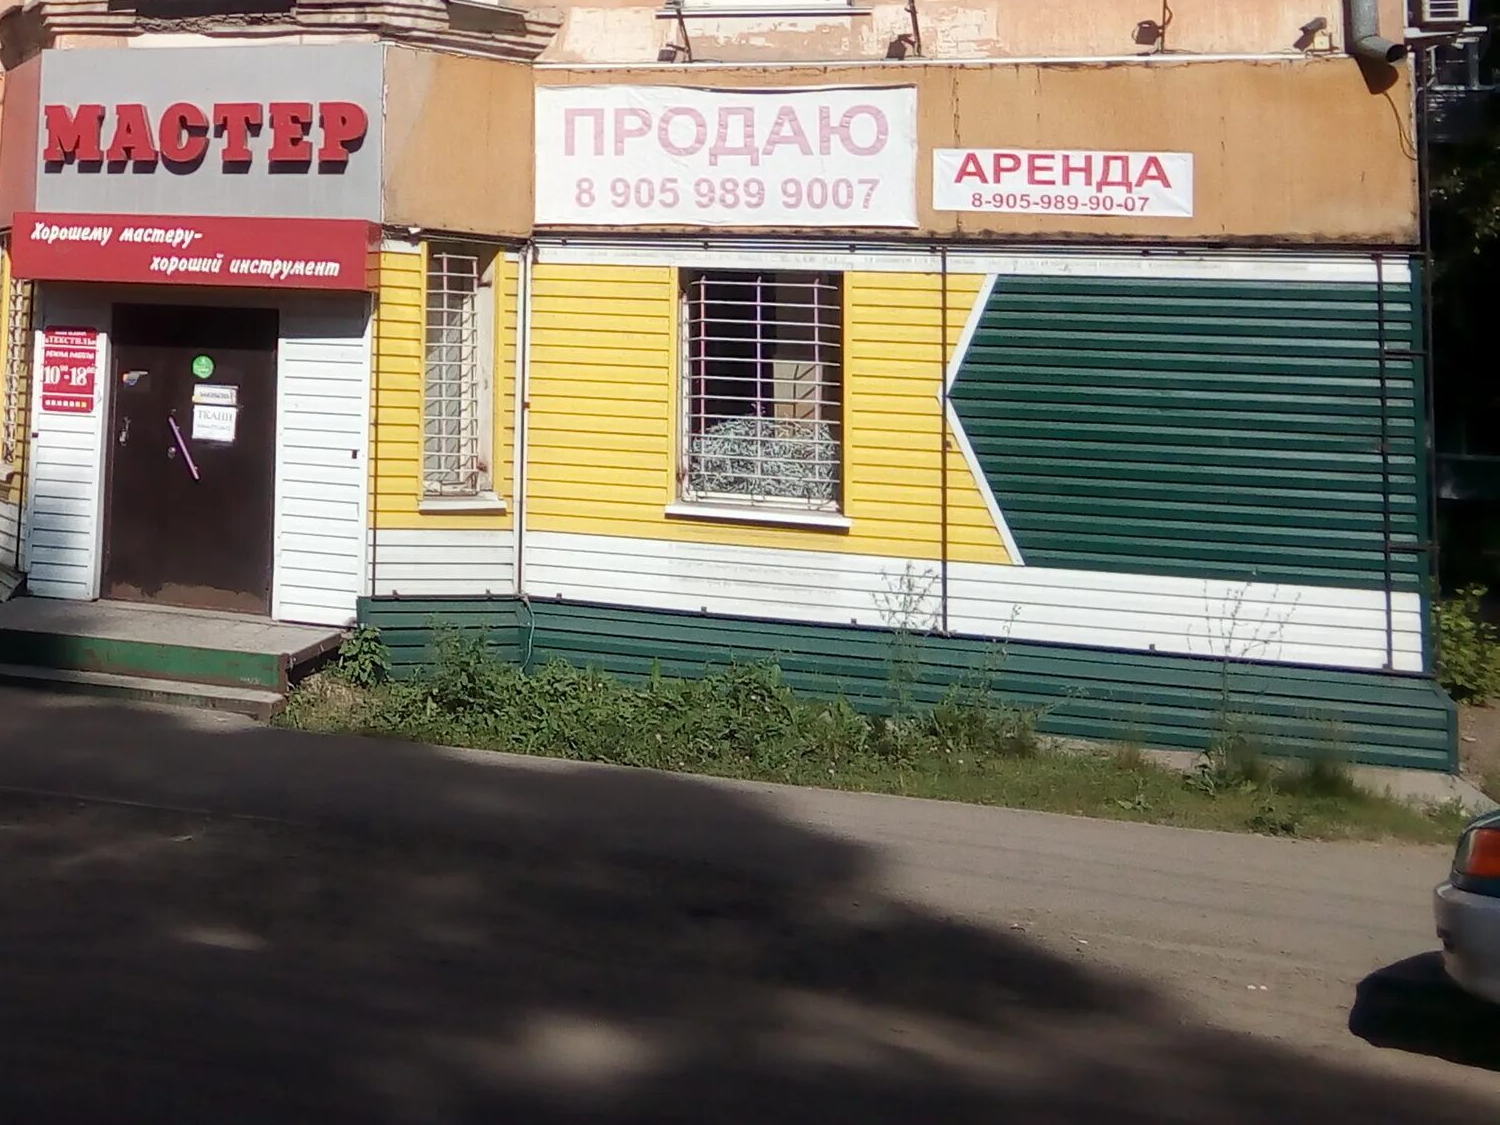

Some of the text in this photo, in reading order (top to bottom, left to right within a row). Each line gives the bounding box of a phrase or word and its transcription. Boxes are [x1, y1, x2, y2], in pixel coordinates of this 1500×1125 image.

[43, 101, 369, 175] МАСТЕР
[563, 105, 889, 167] ПРОДАЮ
[953, 152, 1172, 193] АРЕНДА
[575, 177, 880, 210] 8 905 989 9007
[970, 192, 1150, 212] 8-905-989-90-07
[30, 222, 113, 246] Хорошему
[149, 253, 340, 280] хороший инструмент
